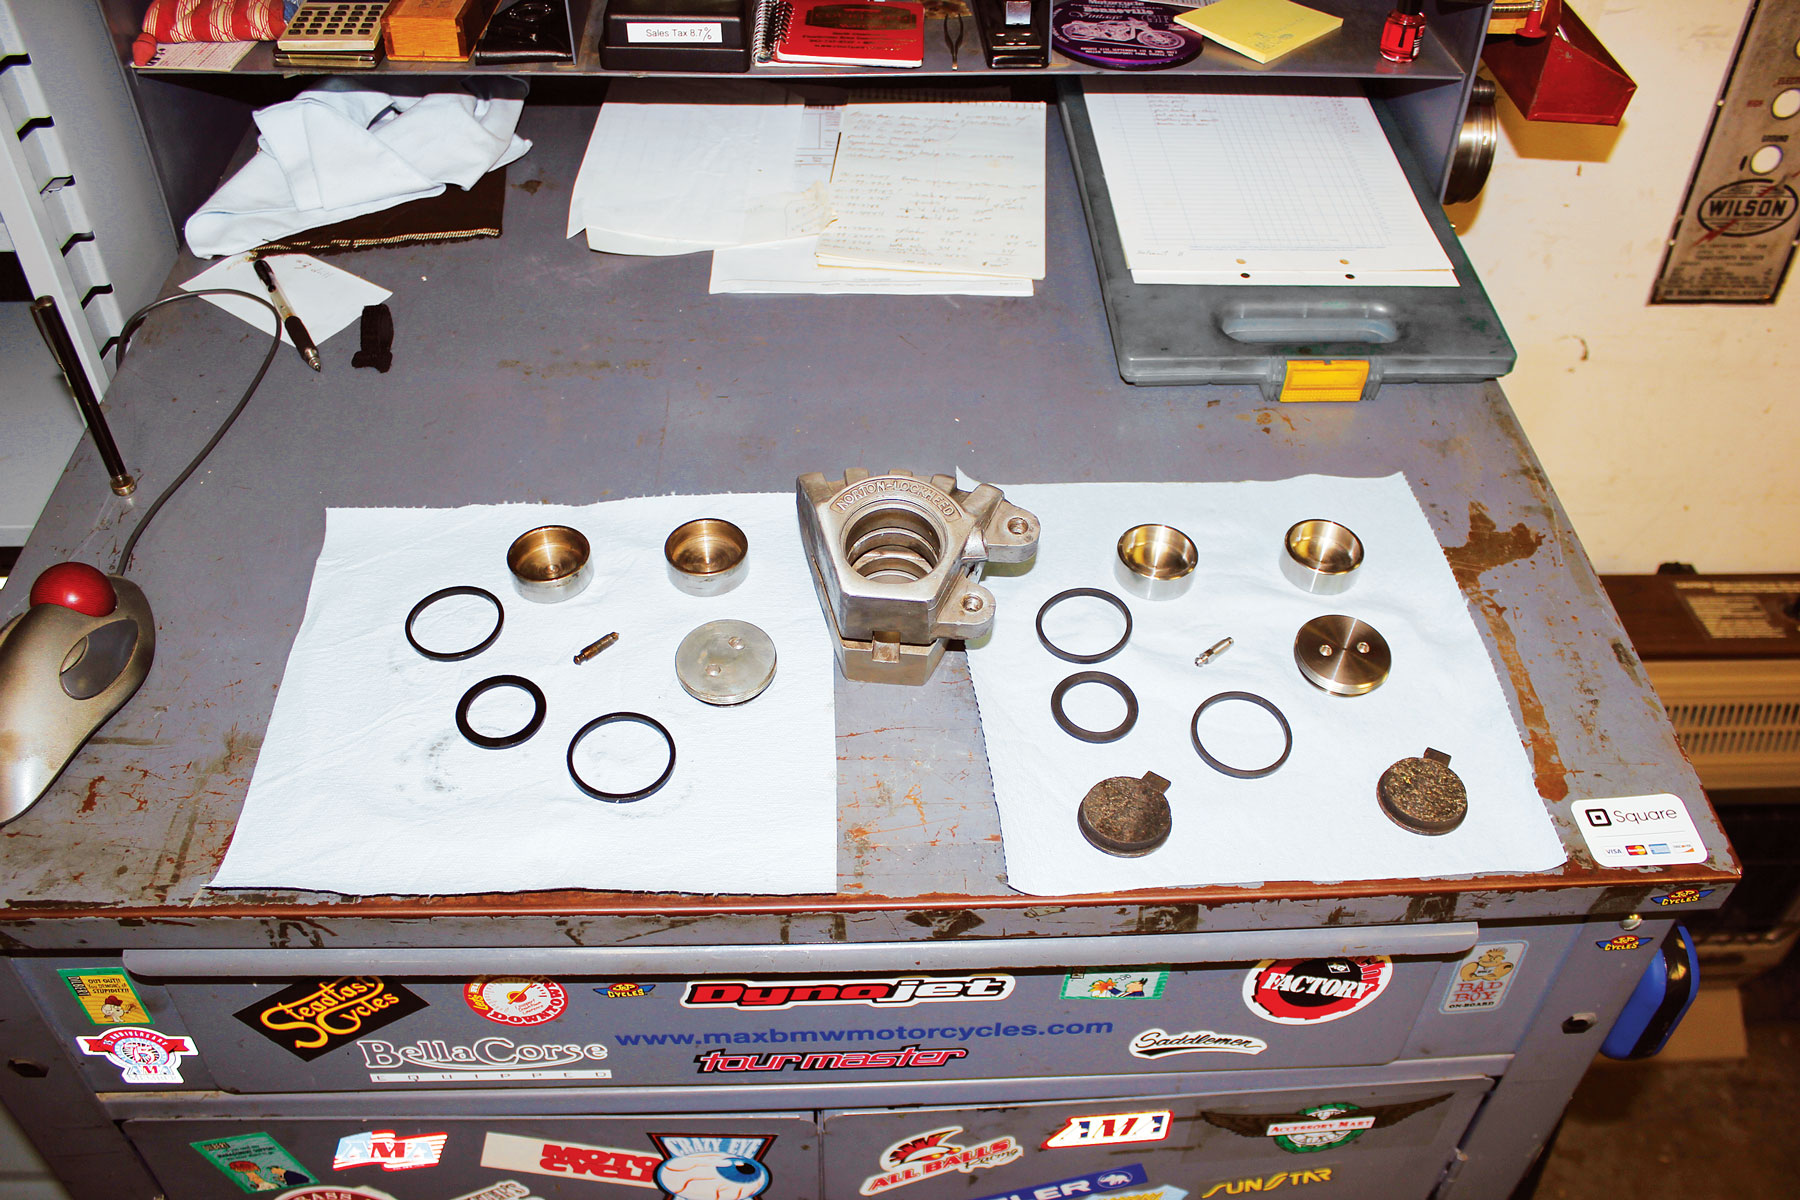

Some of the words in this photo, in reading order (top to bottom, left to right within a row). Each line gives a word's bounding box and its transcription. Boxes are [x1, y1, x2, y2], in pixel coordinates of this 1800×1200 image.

[645, 28, 670, 38] Sales
[672, 28, 688, 38] Tax
[689, 26, 713, 42] 8.7%
[1709, 199, 1787, 217] WILSON
[836, 479, 956, 518] NORTON-LOCKHEED
[1612, 807, 1678, 825] Square
[1661, 893, 1700, 906] CYCLES
[1604, 940, 1640, 951] CYCLES
[607, 988, 646, 998] CYCLES
[686, 978, 1008, 1006] Dynojet
[1261, 972, 1376, 1000] FACTORY
[1457, 980, 1503, 993] BAD
[1453, 991, 1499, 1002] BOY
[260, 976, 376, 1048] Steadfast
[315, 979, 400, 1035] Cycles
[614, 1021, 1114, 1046] www.maxbmwmotorcycles.com
[1135, 1031, 1262, 1049] Saddlemen
[356, 1037, 608, 1070] BellaCorse
[696, 1045, 968, 1073] tourmaster
[131, 1065, 172, 1075] AMA
[1270, 1122, 1335, 1133] ACCESSORY
[1338, 1119, 1373, 1129] MART
[343, 1142, 434, 1159] AMA
[541, 1144, 664, 1169] MOTO
[663, 1137, 722, 1157] CRAZY
[727, 1138, 762, 1159] EYE
[868, 1167, 920, 1191] ALL
[923, 1138, 1011, 1174] BALLS
[1201, 1168, 1332, 1199] SUNSTAR
